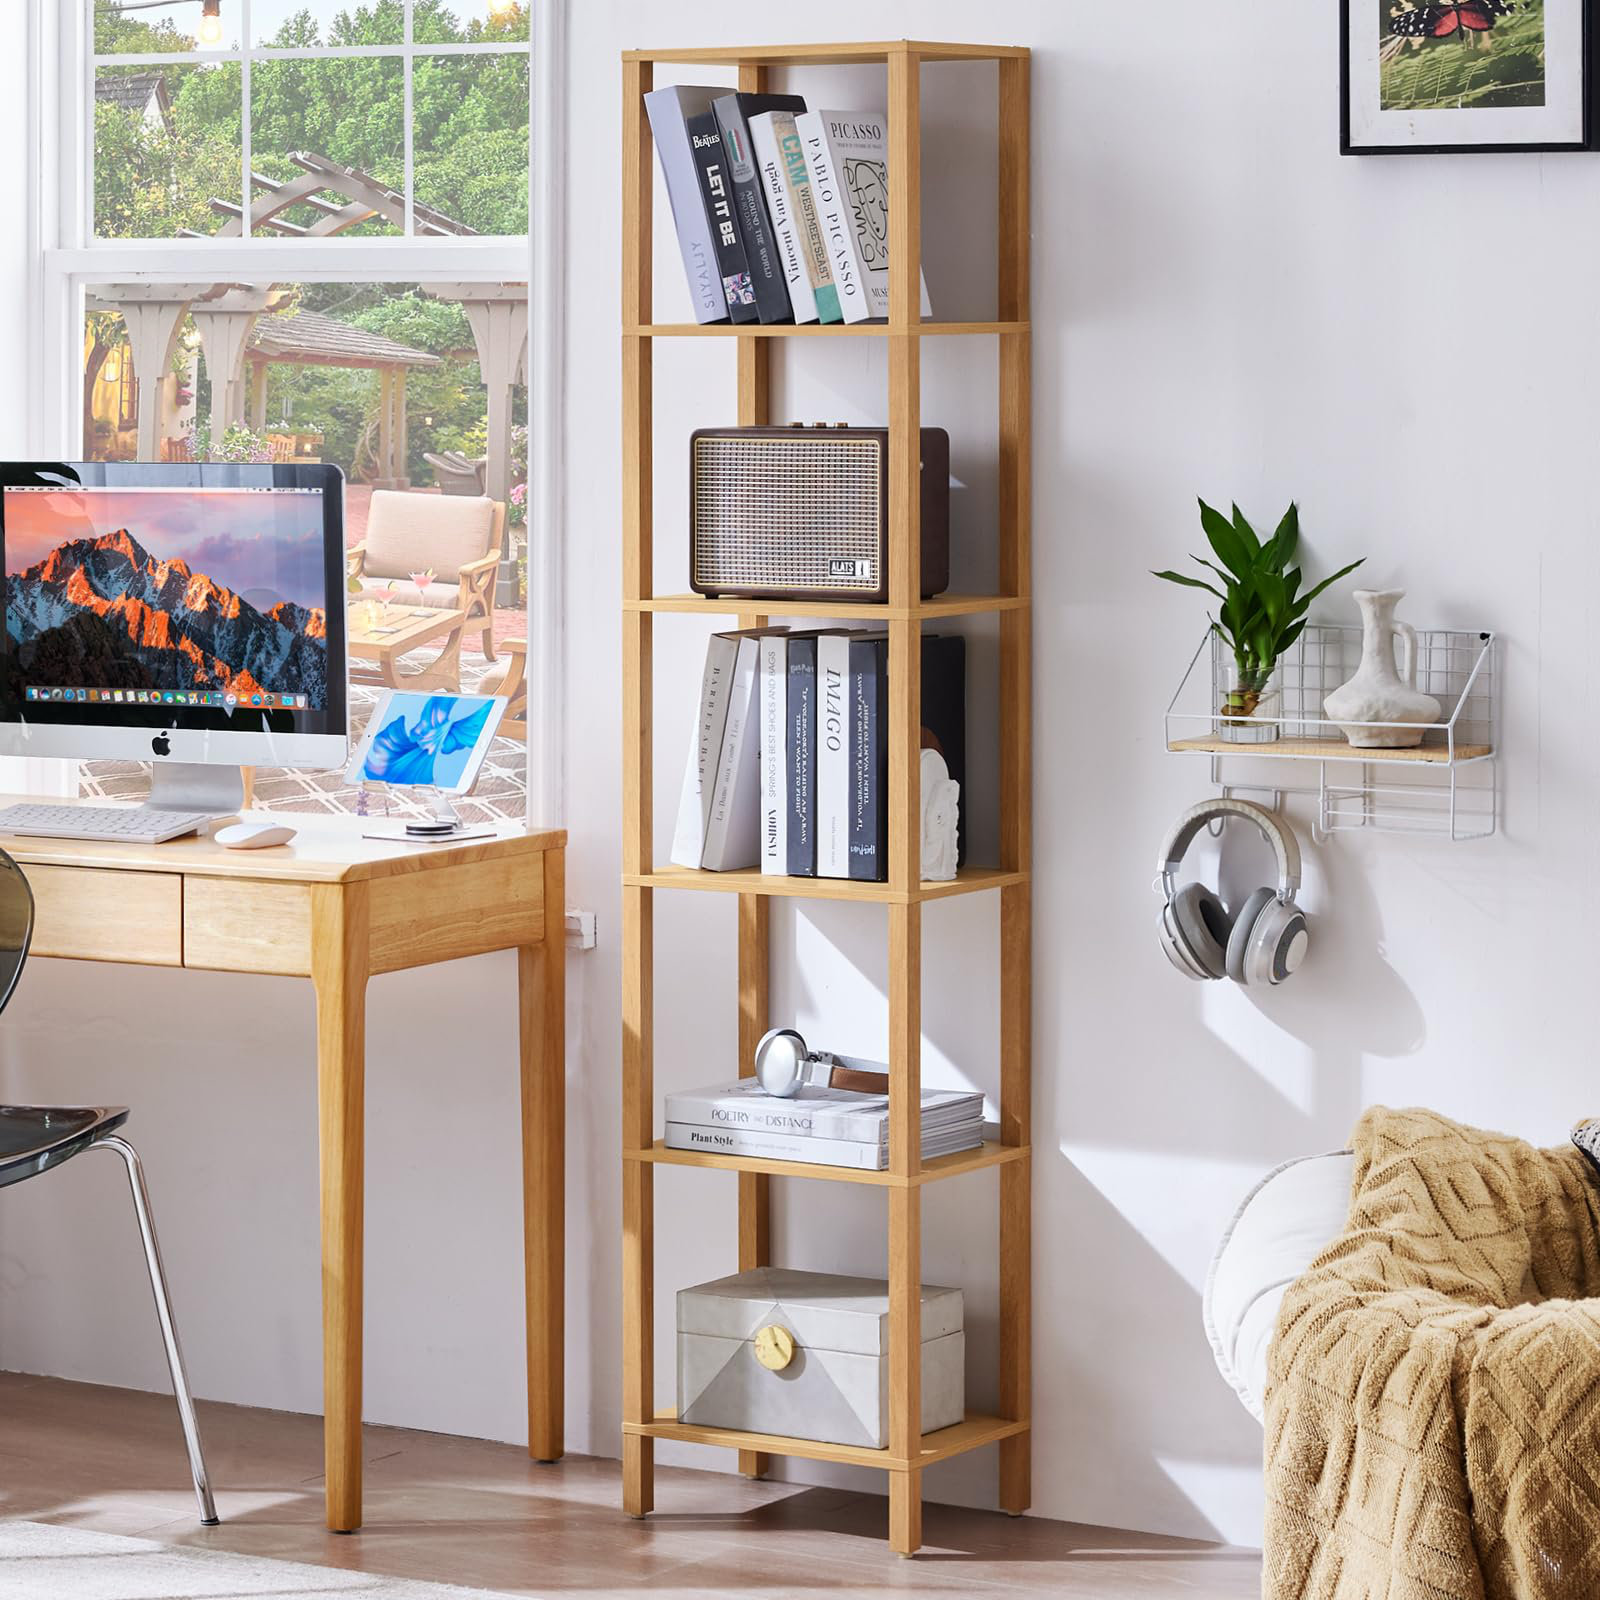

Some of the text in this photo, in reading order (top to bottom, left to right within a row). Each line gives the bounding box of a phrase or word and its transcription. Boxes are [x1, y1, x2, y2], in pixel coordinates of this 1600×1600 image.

[692, 134, 720, 149] BEATLES
[830, 122, 881, 140] PICASSO
[706, 164, 737, 246] LET IT BE
[775, 198, 788, 227] Van
[807, 137, 856, 296] PABLO PICASSO
[745, 190, 760, 226] AROUND
[760, 247, 773, 279] WORLD
[782, 230, 801, 284] Vincent
[767, 651, 777, 677] BAGS
[767, 678, 777, 700] AND
[767, 702, 777, 733] SHOES
[826, 667, 841, 752] IMAGO
[767, 733, 777, 755] BEST
[767, 808, 777, 857] FASHION
[711, 1109, 751, 1123] POETRY
[766, 1115, 816, 1130] DISTANCE
[691, 1131, 712, 1143] Plant
[713, 1134, 734, 1146] Style
